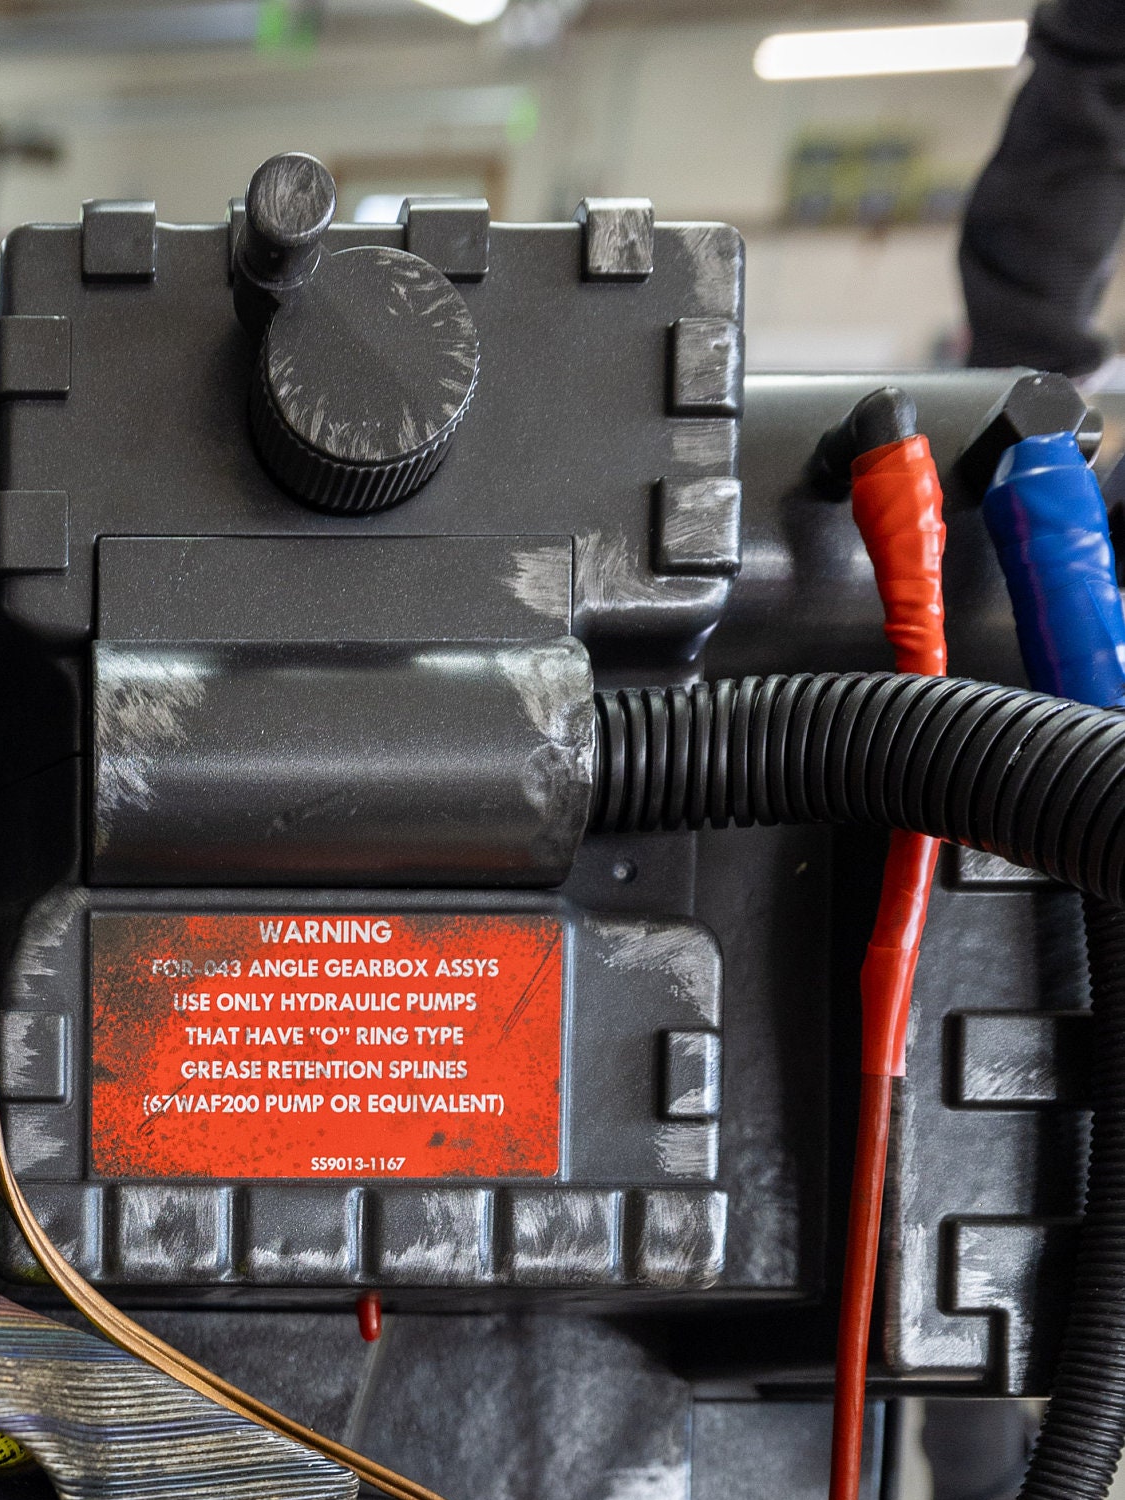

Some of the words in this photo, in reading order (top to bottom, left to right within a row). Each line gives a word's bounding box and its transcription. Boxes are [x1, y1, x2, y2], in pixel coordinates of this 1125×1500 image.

[259, 920, 392, 944] WARNING
[248, 959, 319, 978] ANGLE
[324, 959, 429, 978] GEARBOX
[435, 959, 499, 978] ASSYS
[173, 993, 211, 1012] USE
[216, 993, 275, 1012] ONLY
[280, 993, 401, 1012] HYDRAULIC
[406, 993, 477, 1012] PUMPS
[185, 1027, 239, 1046] THAT
[245, 1027, 304, 1046] HAVE
[356, 1027, 409, 1046] RING
[414, 1027, 464, 1046] TYPE
[181, 1061, 262, 1080] GREASE
[267, 1061, 382, 1080] RETENTION
[389, 1061, 468, 1080] SPLINES
[265, 1095, 325, 1113] PUMP
[331, 1094, 362, 1113] OR
[367, 1094, 505, 1116] EQUIVALENT)
[310, 1157, 406, 1171] SS9013-1167
